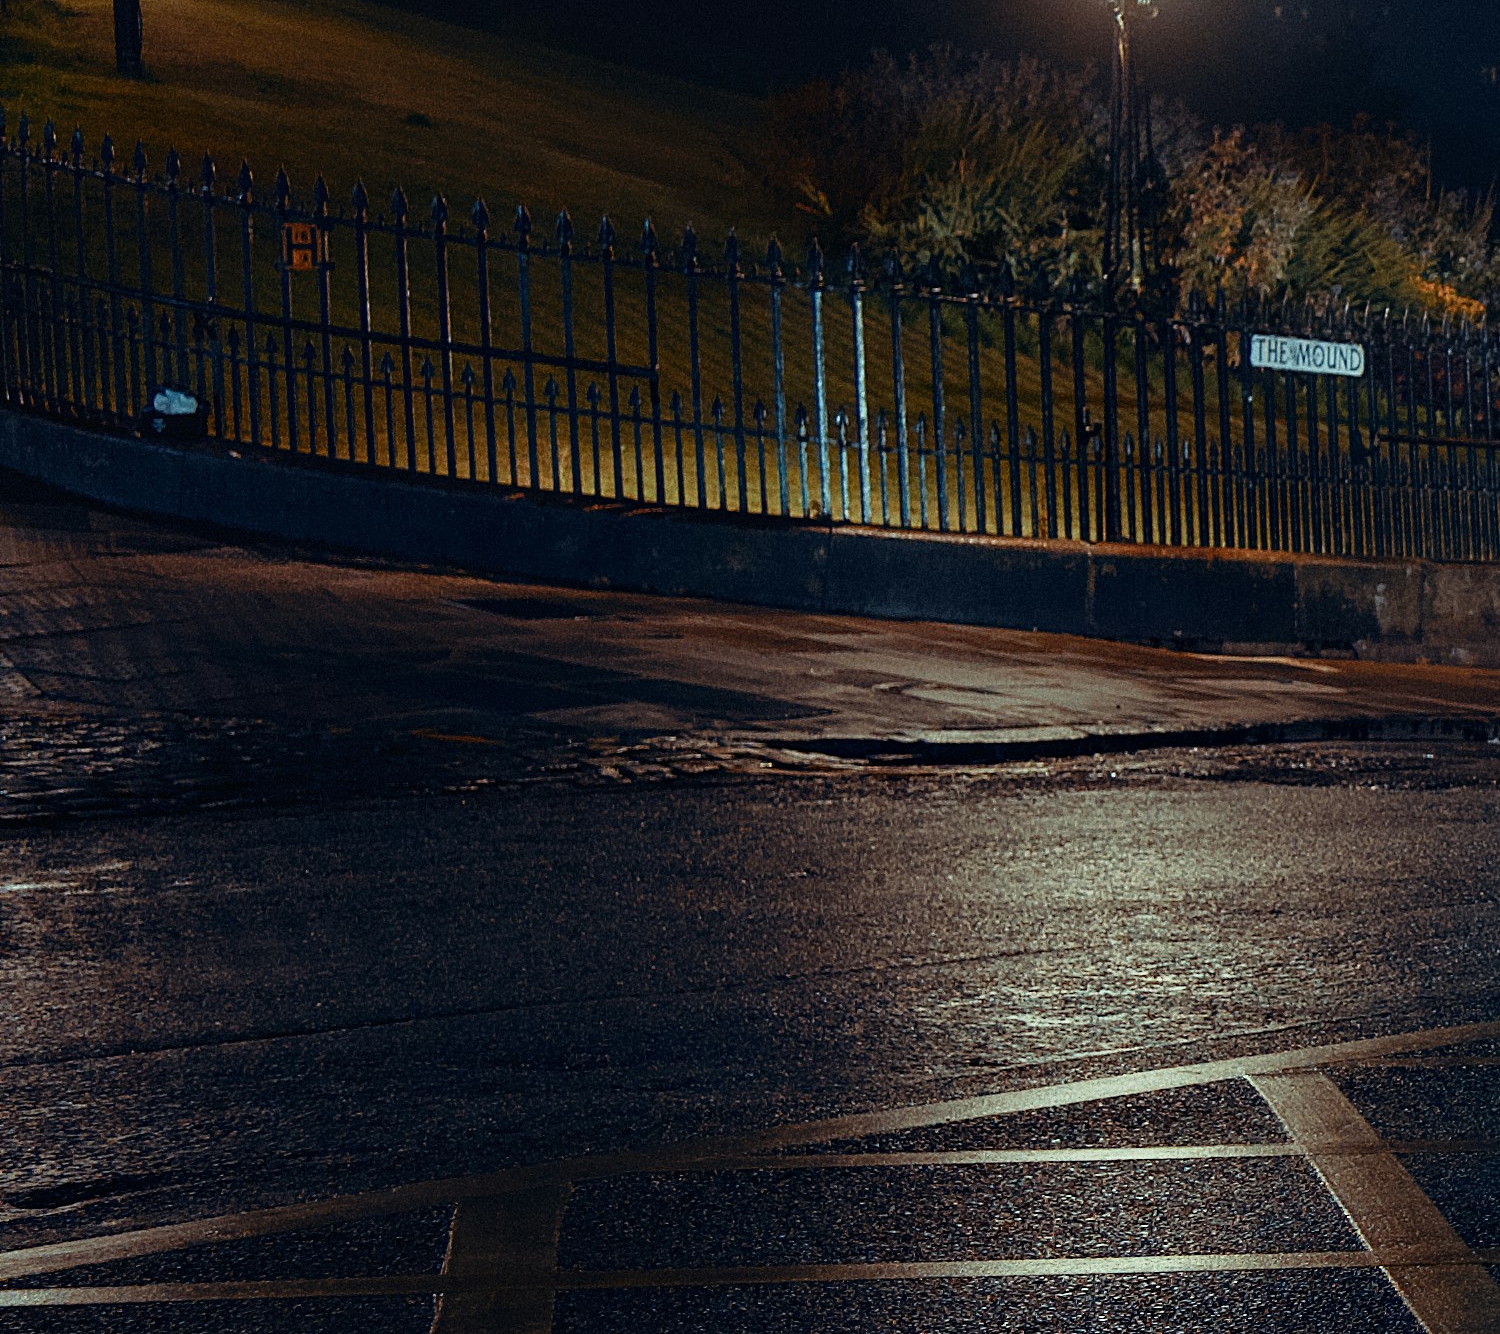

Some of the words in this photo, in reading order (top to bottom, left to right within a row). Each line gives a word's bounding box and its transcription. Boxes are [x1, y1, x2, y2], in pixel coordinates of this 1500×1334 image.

[286, 226, 317, 267] H
[1254, 338, 1288, 365] THE
[1295, 343, 1362, 372] MOUND
